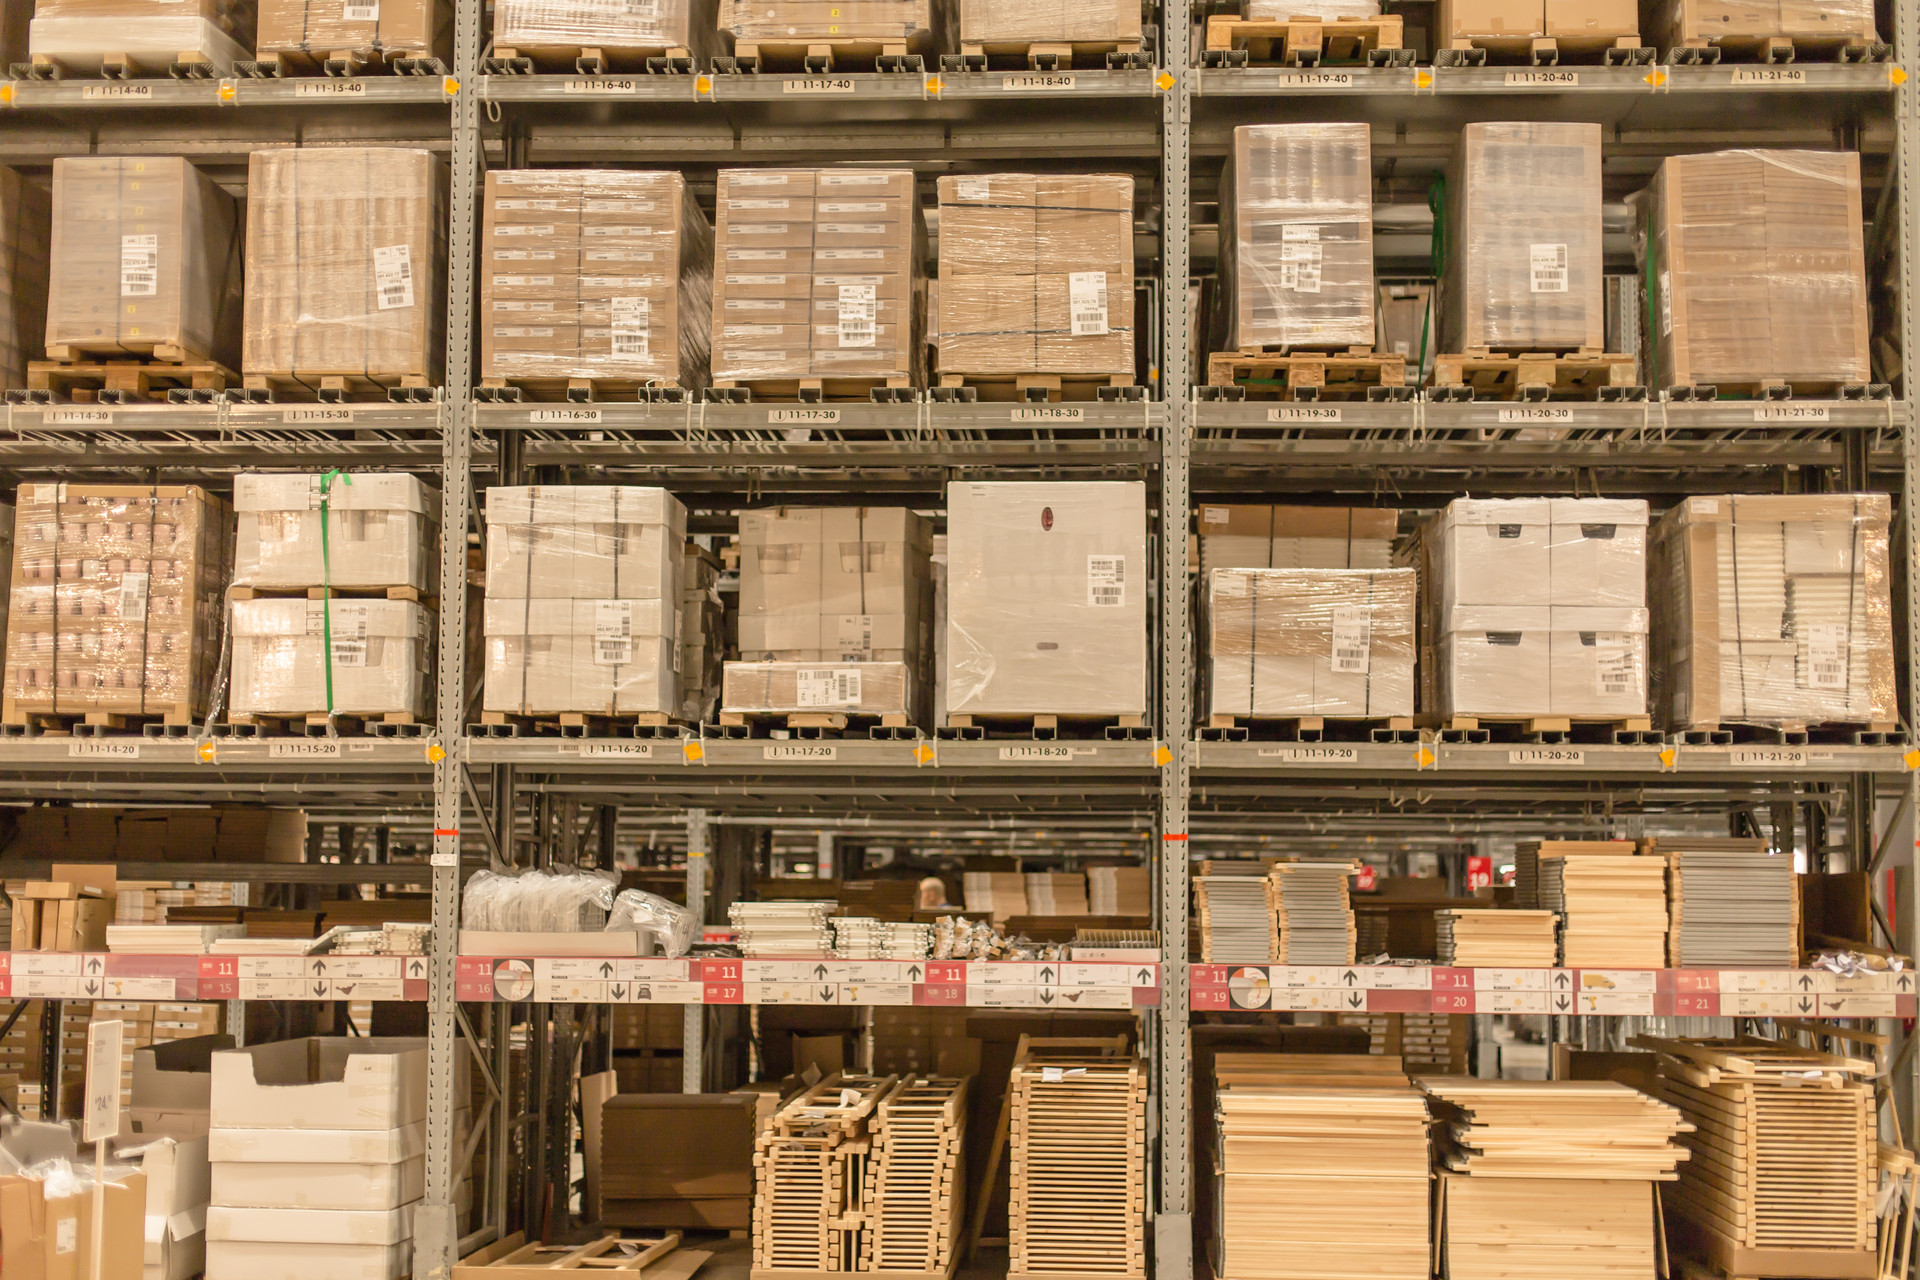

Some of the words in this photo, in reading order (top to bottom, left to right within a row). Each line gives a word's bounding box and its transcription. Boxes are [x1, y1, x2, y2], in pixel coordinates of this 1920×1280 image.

[1299, 74, 1348, 83] 11-19-40
[1525, 73, 1574, 82] 11-20-40
[1750, 70, 1801, 80] 11-21-40
[583, 80, 632, 90] 11-16-40
[803, 80, 851, 89] 11-17-40
[1022, 76, 1071, 86] 11-18-40
[315, 82, 362, 92] 11-15-40
[64, 411, 109, 420] 11-14-30
[304, 410, 349, 419] 11-15-30
[551, 410, 597, 419] 11-16-30
[789, 410, 836, 419] 11-17-30
[1032, 408, 1079, 418] 11-18-30
[1289, 408, 1337, 418] 11-19-30
[1520, 408, 1568, 418] 11-20-30
[1775, 407, 1824, 417] 11-21-30
[89, 744, 135, 754] 11-14-20
[290, 744, 336, 753] 11-15-20
[601, 744, 648, 753] 11-16-20
[785, 747, 832, 756] 11-17-20
[1021, 746, 1068, 756] 11-18-20
[1305, 748, 1353, 758] 11-19-20
[1531, 750, 1580, 760] 11-20-20
[1753, 752, 1801, 761] 11-21-20
[218, 962, 233, 975] 11
[478, 963, 492, 976] 11
[722, 966, 737, 979] 11
[946, 968, 961, 981] 11
[1212, 970, 1227, 983] 11
[1453, 974, 1468, 987] 11
[1695, 977, 1711, 990] 11
[219, 983, 232, 993] 15
[477, 984, 491, 994] 16
[723, 988, 737, 998] 17
[945, 988, 957, 999] 18
[1213, 992, 1227, 1003] 19
[1453, 996, 1467, 1007] 20
[1695, 998, 1709, 1010] 21
